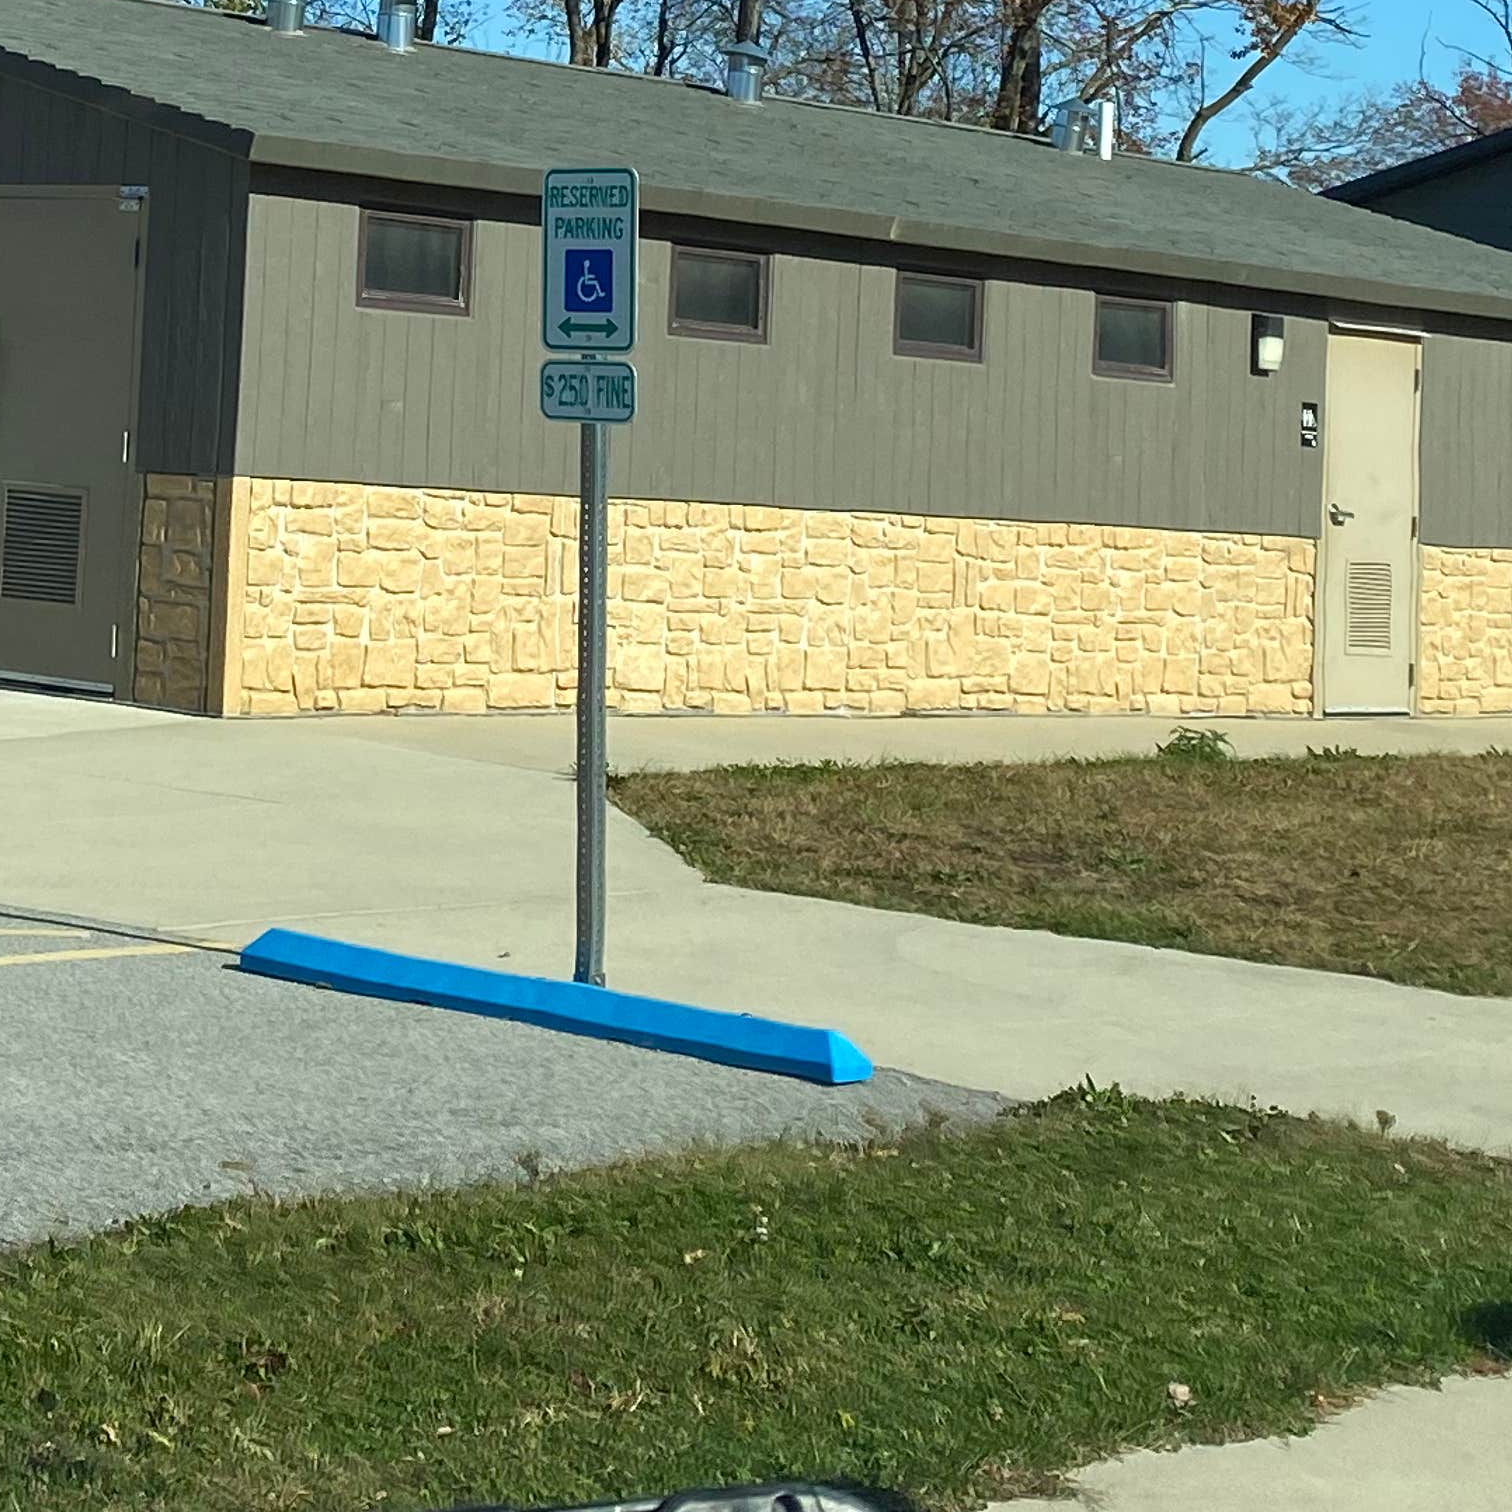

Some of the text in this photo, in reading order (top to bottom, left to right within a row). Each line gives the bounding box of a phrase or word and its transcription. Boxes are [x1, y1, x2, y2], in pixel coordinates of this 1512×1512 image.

[549, 185, 629, 207] RESERVED
[554, 217, 624, 240] PARKING
[596, 375, 631, 408] FINE
